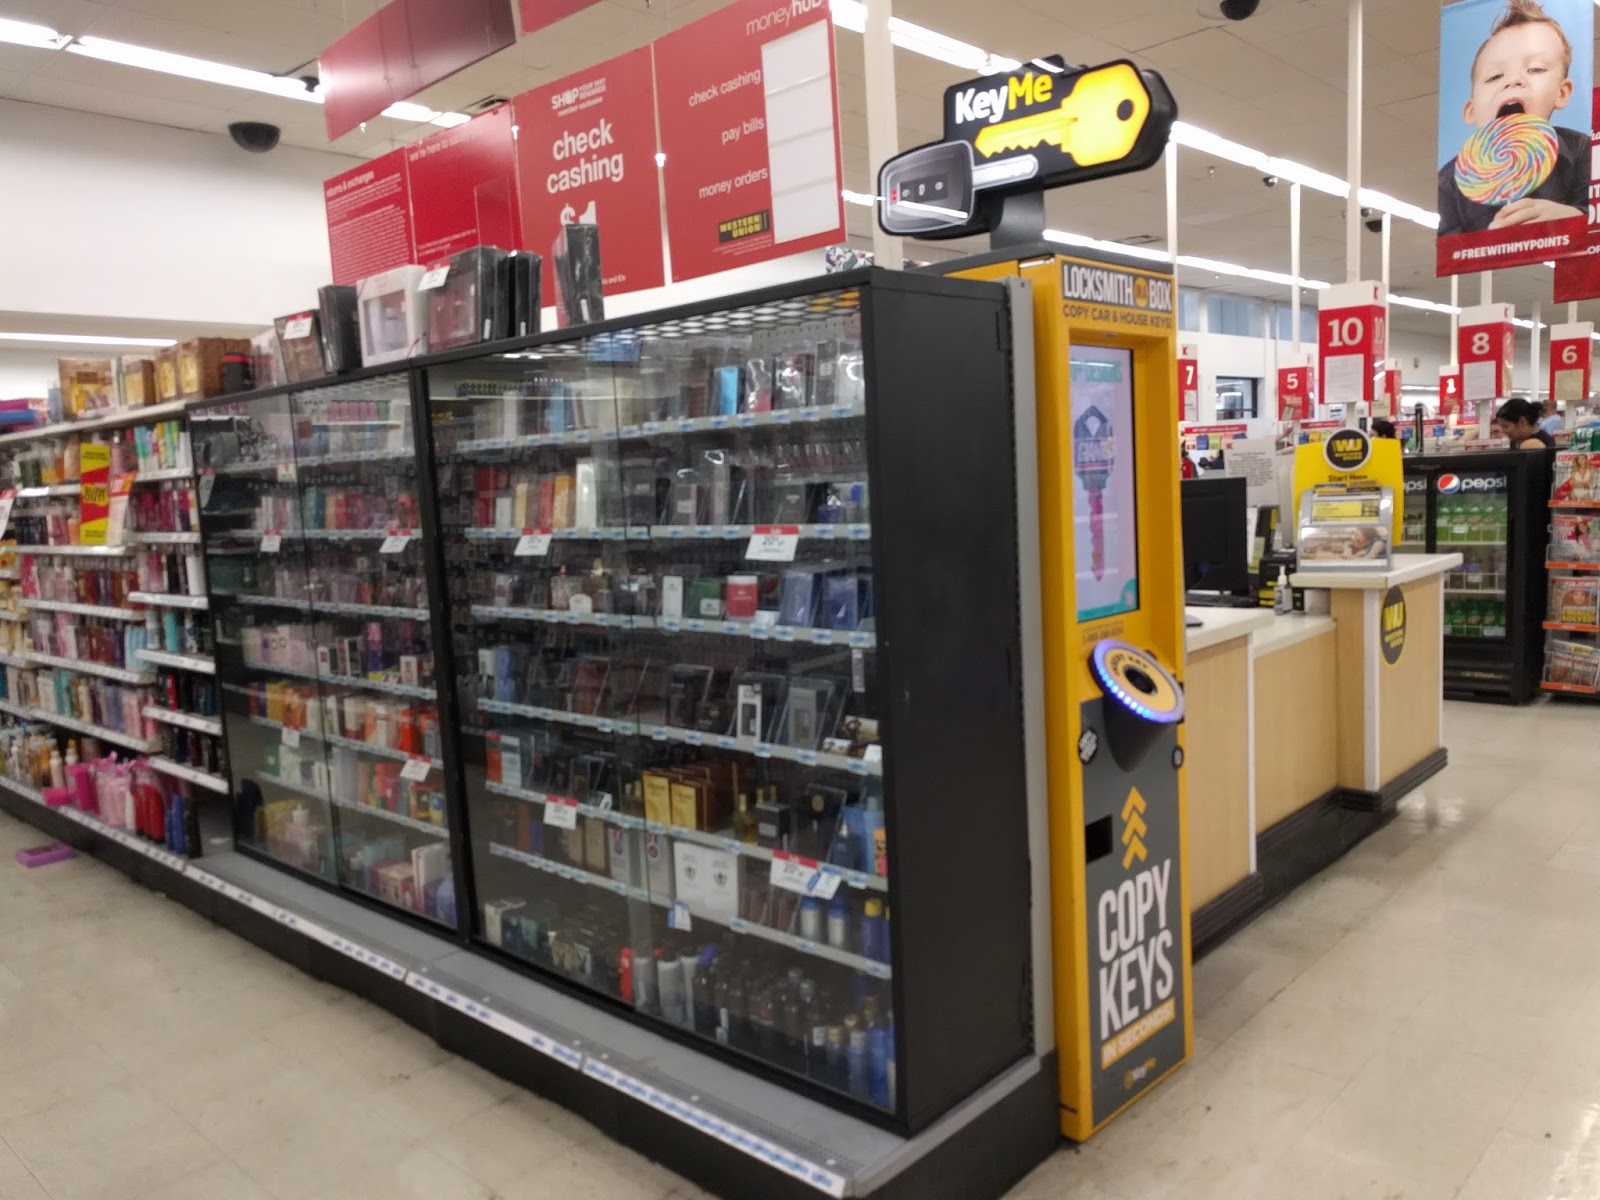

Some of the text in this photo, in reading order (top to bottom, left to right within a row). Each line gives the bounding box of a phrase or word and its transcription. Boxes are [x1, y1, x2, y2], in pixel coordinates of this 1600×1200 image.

[688, 69, 761, 107] check cashing
[955, 72, 1053, 123] KeyMe
[553, 118, 614, 160] check
[722, 117, 765, 145] pay bills
[547, 153, 624, 194] cashing
[699, 167, 768, 199] money orders
[1452, 235, 1570, 259] #FREEWITHMYPOINTS
[1063, 264, 1134, 306] LOCKSMITH
[1148, 279, 1172, 311] BOX
[1062, 304, 1089, 318] COPY
[1091, 307, 1111, 321] CAR
[1328, 317, 1363, 347] 10
[1471, 332, 1490, 355] 8
[1561, 345, 1578, 364] 6
[1185, 365, 1194, 385] 7
[1286, 373, 1299, 390] 5
[1446, 378, 1456, 394] 1
[1461, 475, 1507, 492] pepsi
[1098, 858, 1172, 963] COPY
[1099, 929, 1174, 1041] KEYS
